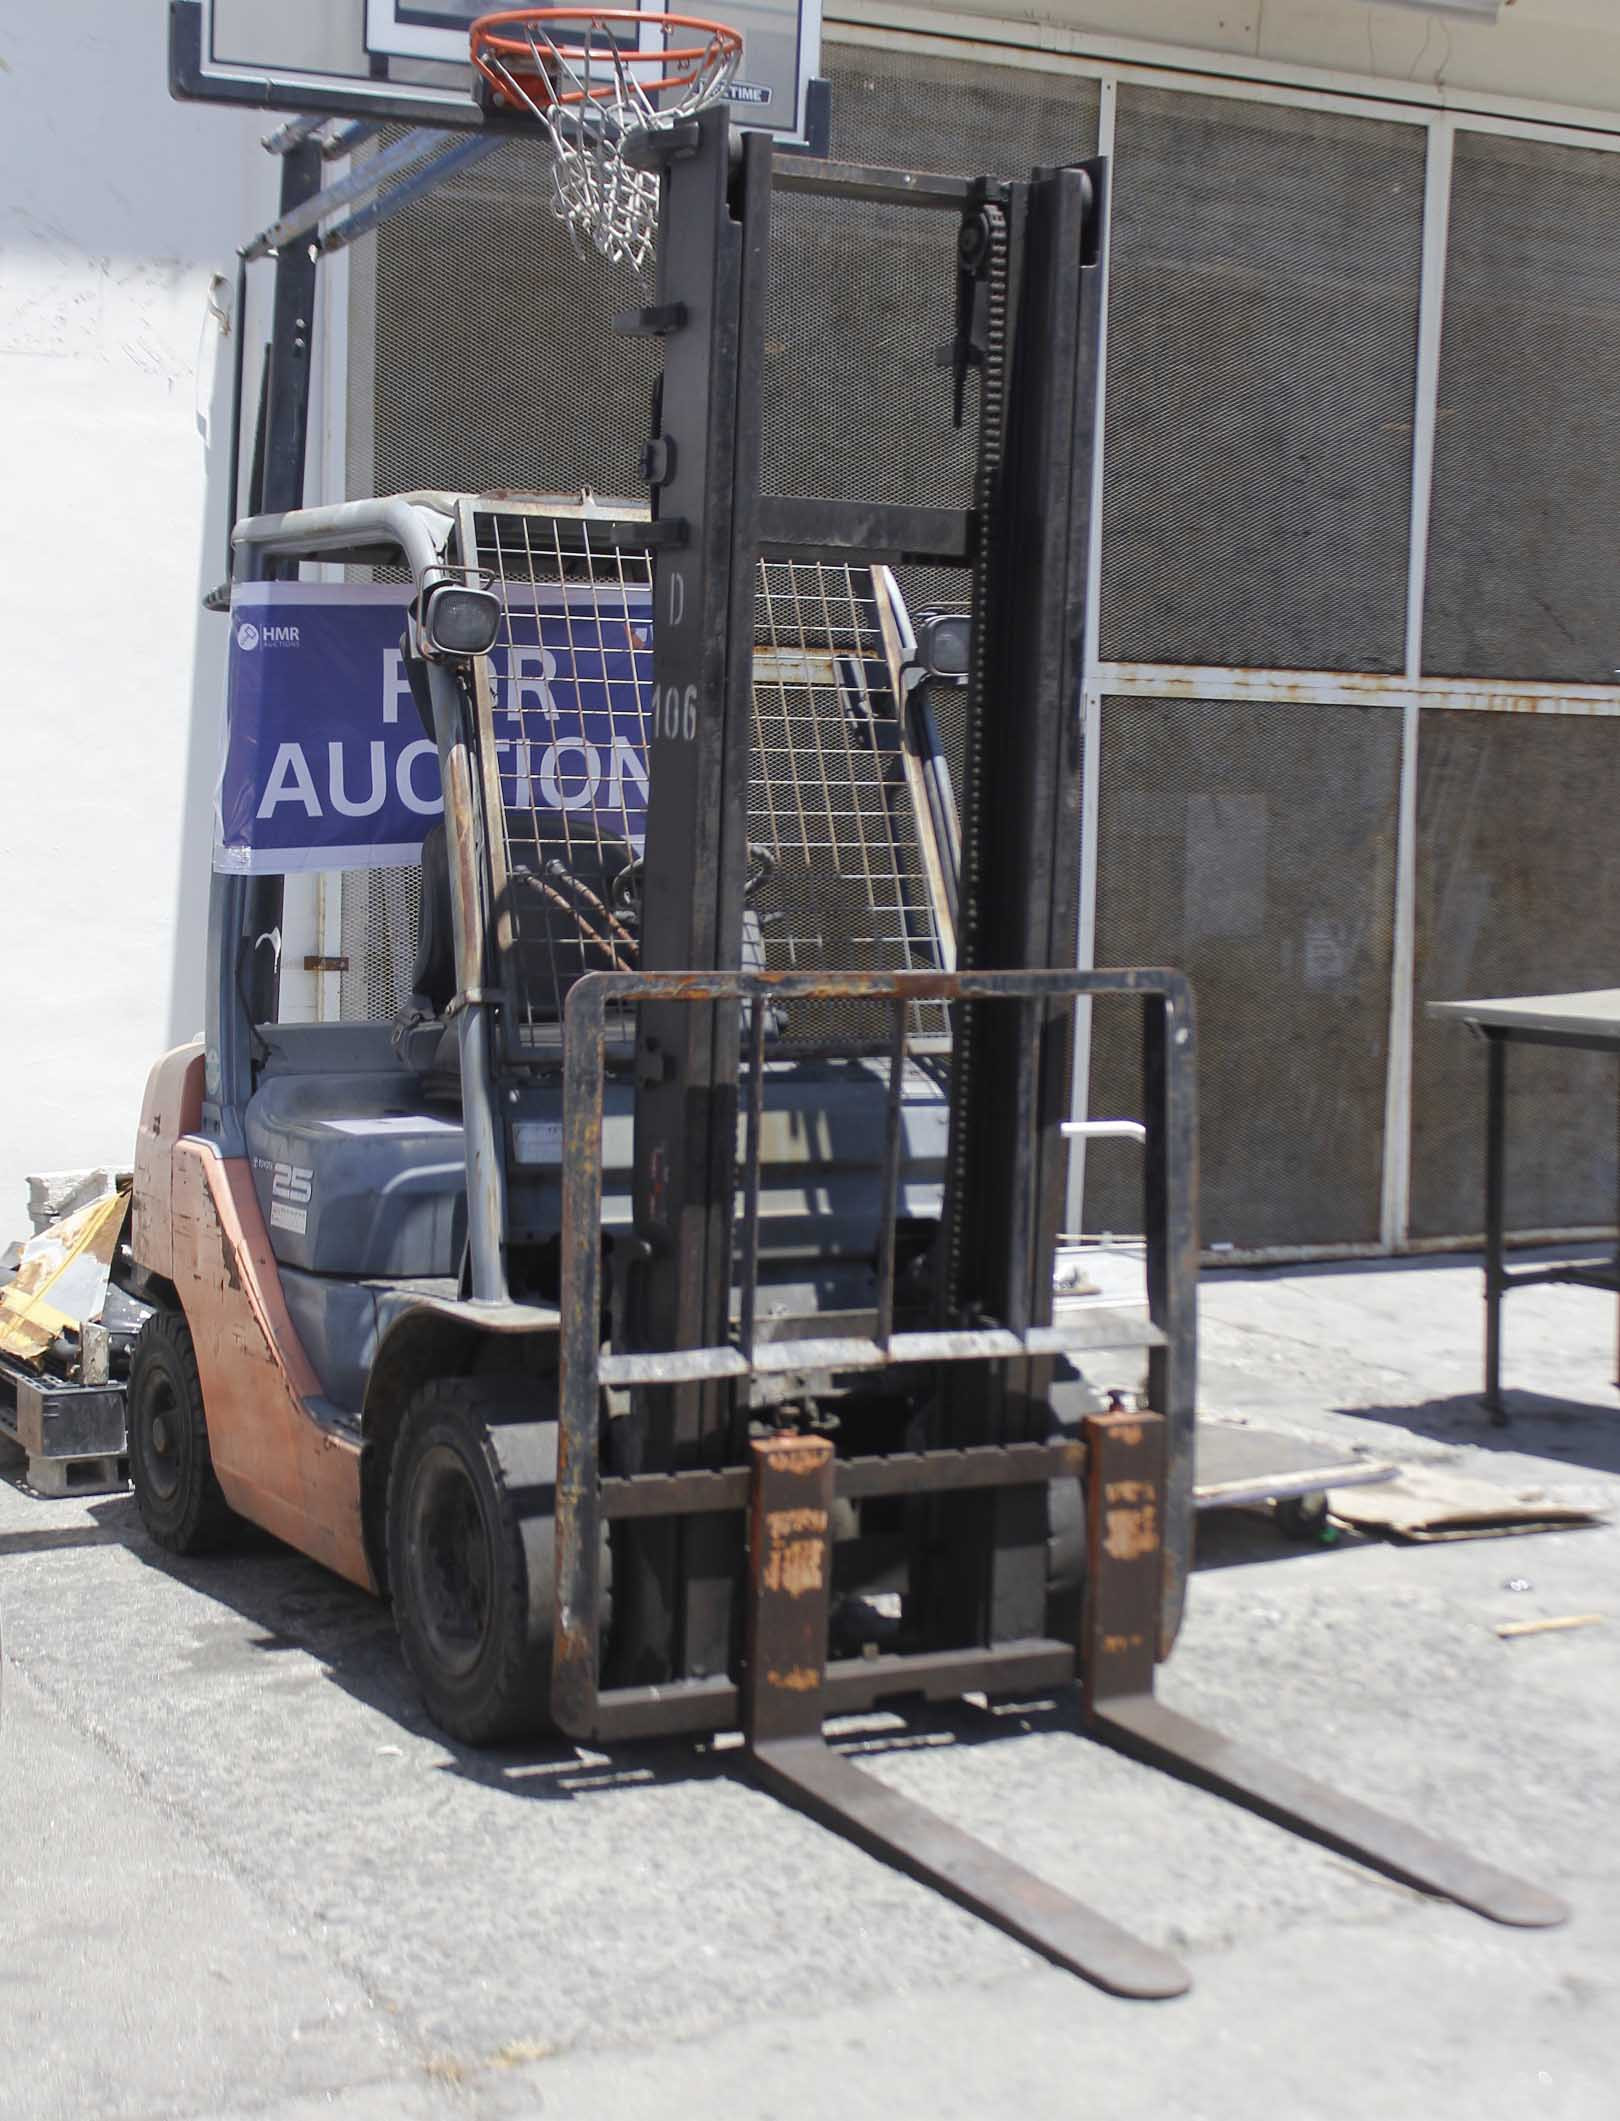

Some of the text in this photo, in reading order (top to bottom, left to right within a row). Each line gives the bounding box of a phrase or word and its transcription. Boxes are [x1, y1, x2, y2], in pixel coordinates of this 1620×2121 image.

[669, 572, 685, 625] D
[263, 626, 300, 641] HMR
[652, 684, 698, 741] 106
[255, 735, 649, 819] AUCION
[272, 1162, 314, 1203] 25
